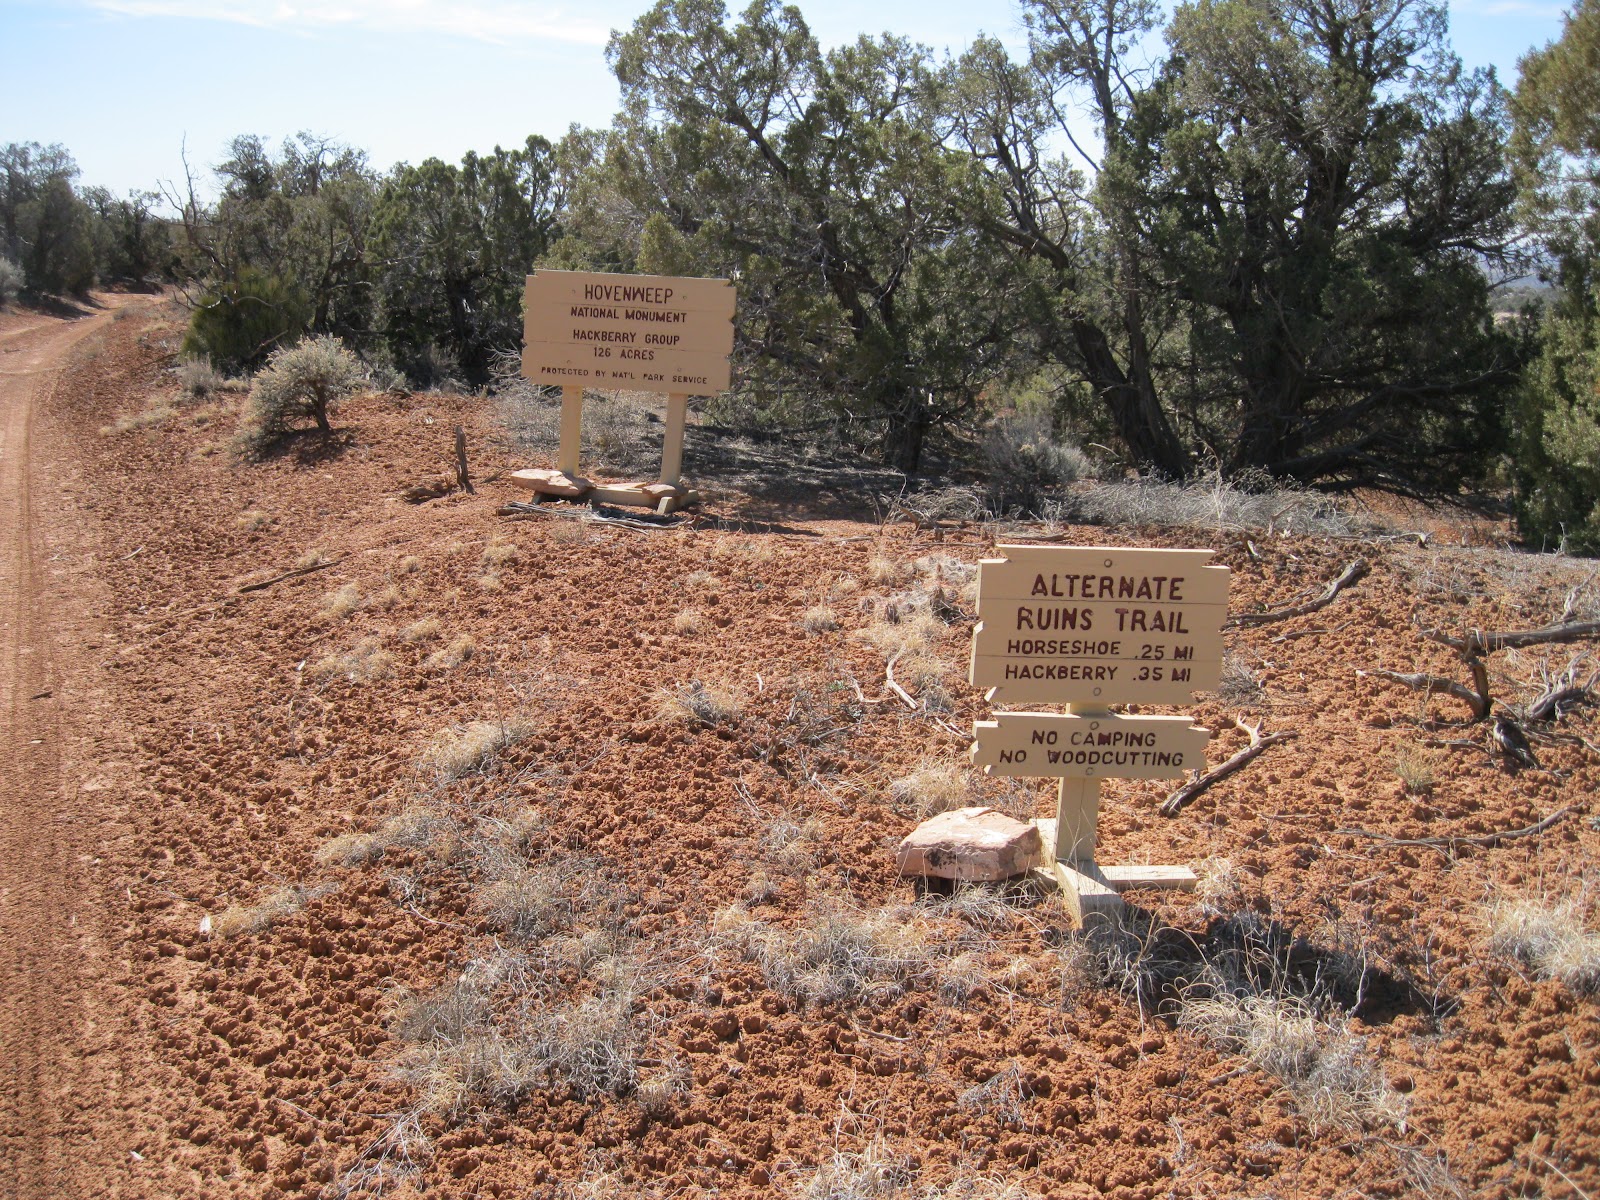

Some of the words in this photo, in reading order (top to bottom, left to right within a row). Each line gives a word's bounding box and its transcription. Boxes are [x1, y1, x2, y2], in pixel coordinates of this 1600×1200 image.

[584, 283, 674, 304] HOVENWEEP
[570, 306, 619, 320] NATIONAL
[625, 309, 687, 323] MONUMENT
[572, 329, 636, 343] HACKBERRY
[645, 333, 680, 346] GROUP
[593, 347, 611, 358] 126
[620, 348, 655, 361] ACRES
[541, 366, 589, 376] PROTECTED
[595, 369, 606, 378] BY
[612, 370, 635, 380] NAT'L
[643, 373, 664, 381] PARK
[672, 375, 708, 385] SERVICE
[1031, 573, 1185, 600] ALTERNATE
[1016, 606, 1094, 631] RUINS
[1114, 608, 1189, 634] TRAIL
[1007, 639, 1121, 655] HORSESHOE
[1134, 644, 1165, 660] .25
[1173, 645, 1194, 660] MI
[1005, 664, 1118, 681] HACKBERRY
[1132, 666, 1163, 681] .35
[1171, 667, 1191, 682] MI
[1031, 729, 1058, 745] NO
[1070, 730, 1156, 747] CAMPING
[999, 749, 1027, 764] NO
[1047, 749, 1184, 767] WOODCUTTING
